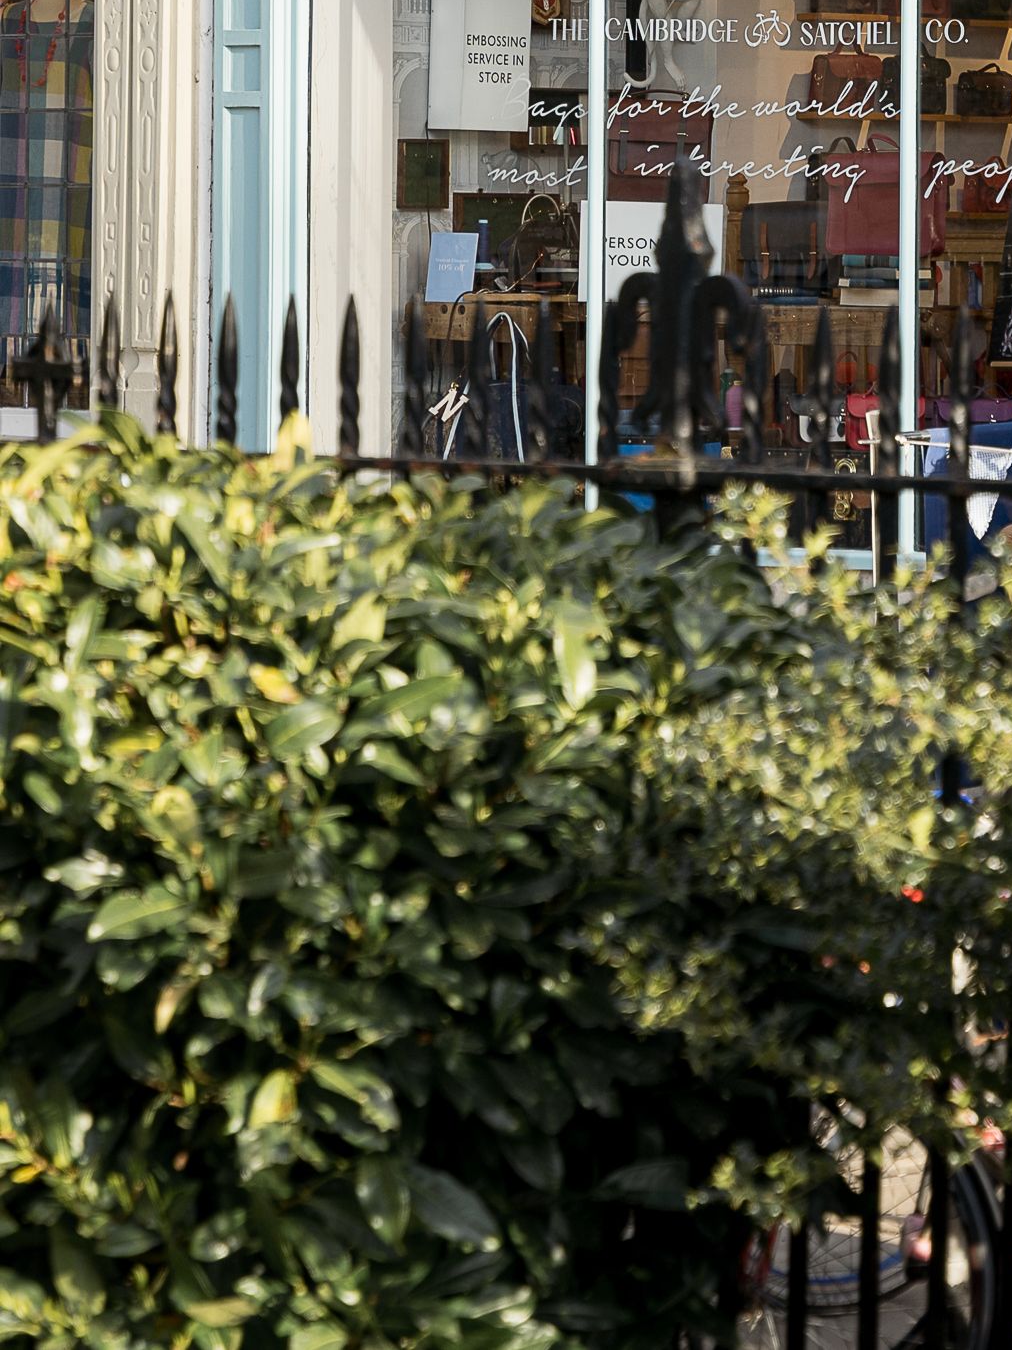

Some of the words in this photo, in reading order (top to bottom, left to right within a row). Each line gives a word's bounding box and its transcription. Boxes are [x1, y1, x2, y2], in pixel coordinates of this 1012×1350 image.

[548, 18, 588, 41] THE
[604, 17, 738, 43] CAMBRIDGE
[800, 21, 898, 47] SATCHEL
[924, 19, 969, 44] CO.
[466, 33, 527, 49] EMBOSSING
[467, 52, 509, 66] SERVICE
[512, 54, 524, 66] IN
[478, 71, 513, 84] STORE
[500, 73, 588, 140] Bags
[606, 82, 672, 130] for
[677, 84, 746, 118] the
[751, 80, 901, 119] world's
[487, 155, 588, 187] most
[608, 254, 652, 267] YOUR
